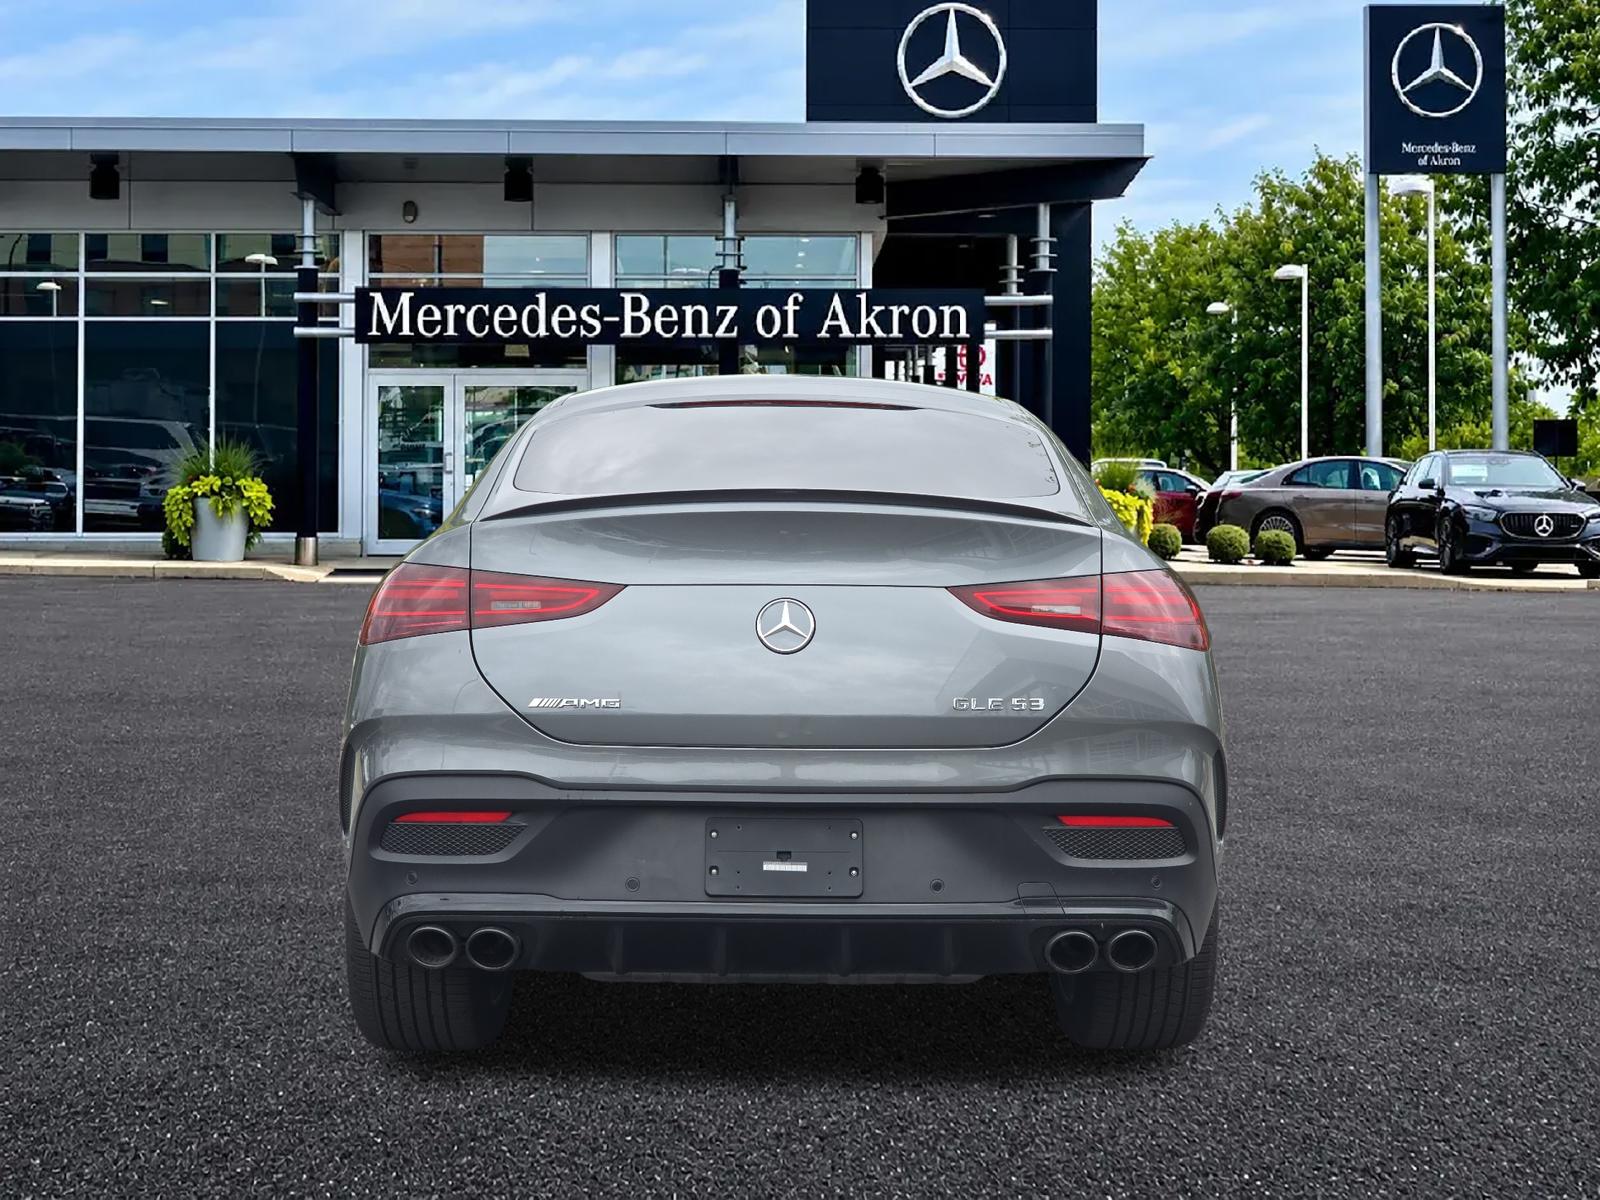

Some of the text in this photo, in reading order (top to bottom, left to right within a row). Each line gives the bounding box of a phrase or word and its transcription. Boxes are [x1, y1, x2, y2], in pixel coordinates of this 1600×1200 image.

[1401, 142, 1476, 153] Mercedes-Benz
[1418, 154, 1460, 165] of Akron
[368, 291, 970, 339] Mercedes-Benz of Akron
[559, 698, 621, 709] AMG
[952, 697, 1045, 711] GLE 53
